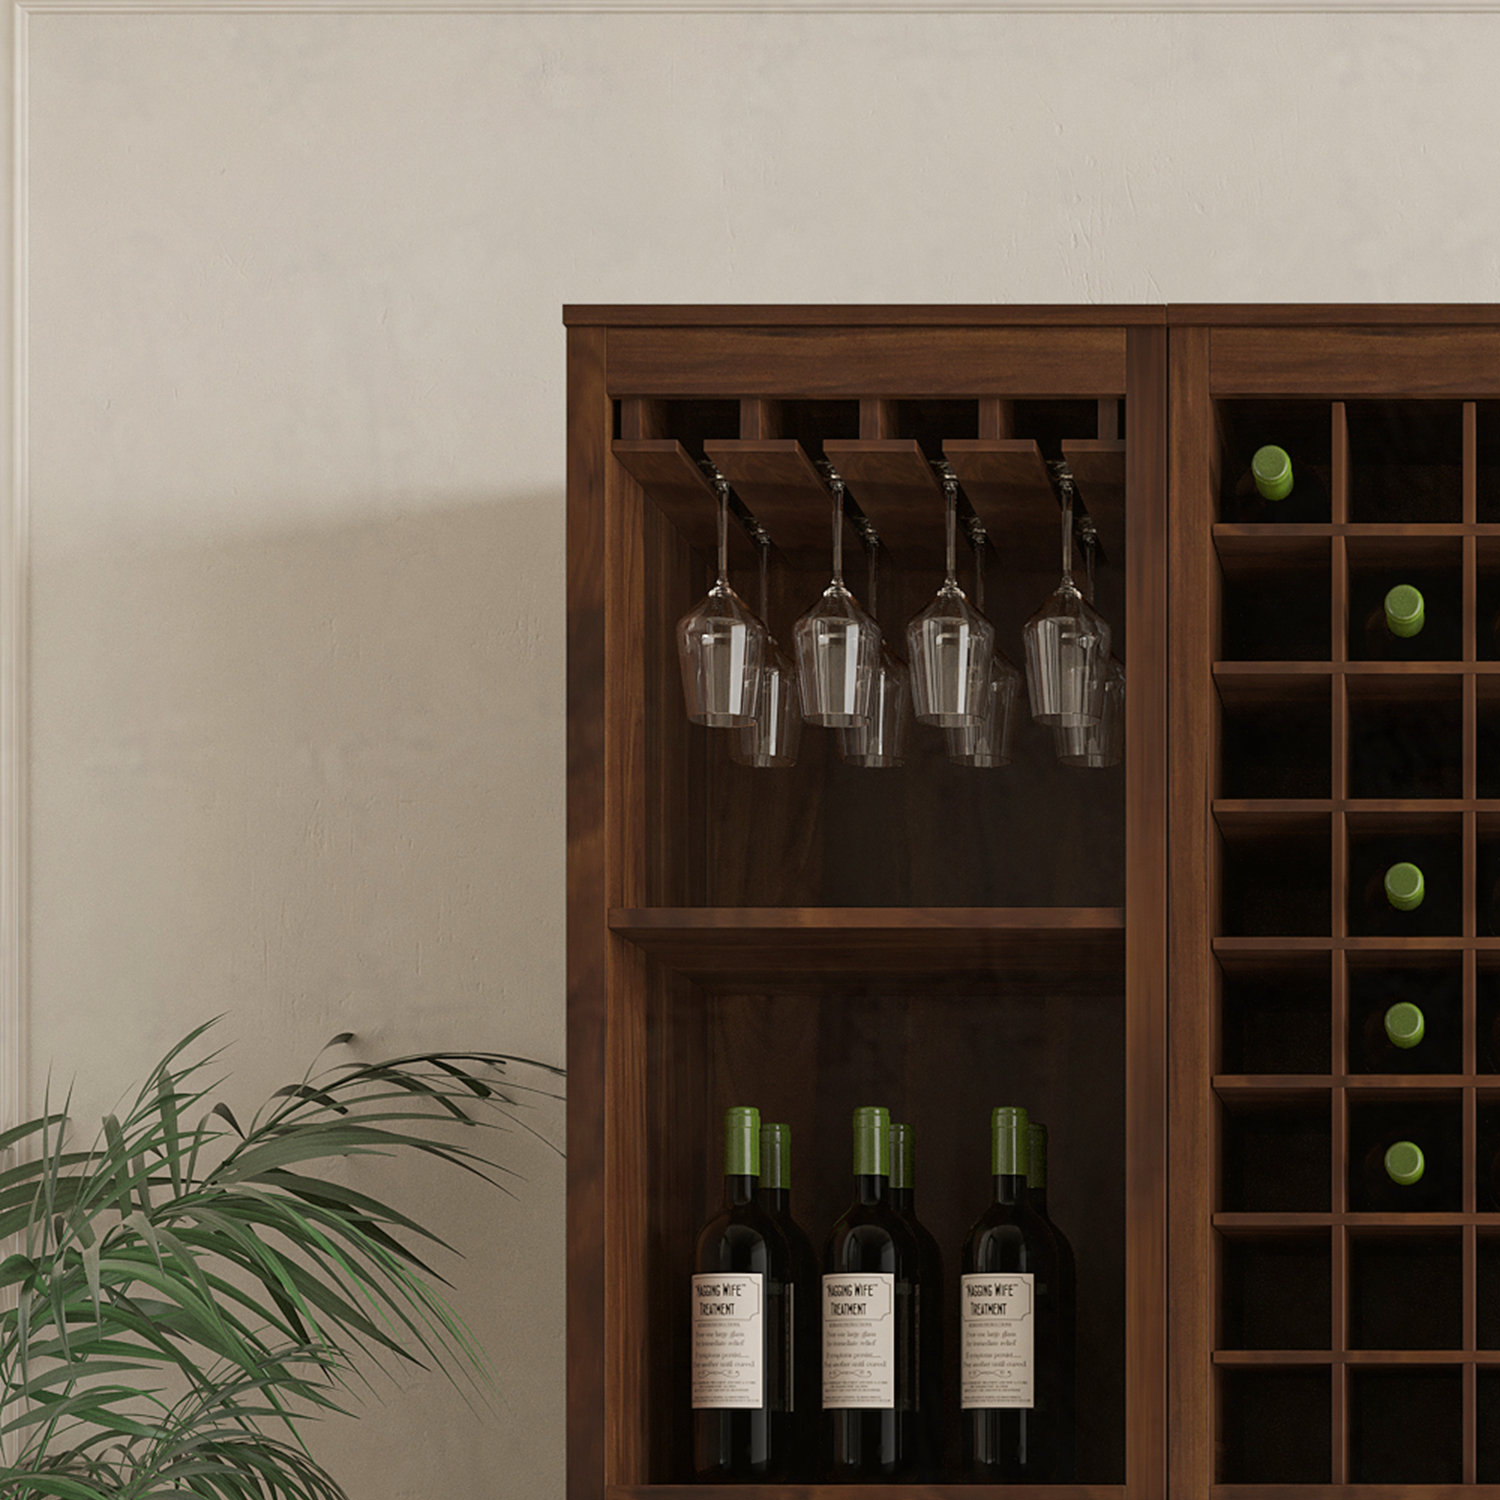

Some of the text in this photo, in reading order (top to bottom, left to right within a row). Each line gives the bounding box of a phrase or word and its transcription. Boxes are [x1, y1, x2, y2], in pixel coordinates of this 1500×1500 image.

[700, 1302, 735, 1316] TREATMENT
[831, 1302, 866, 1316] TREATMENT
[970, 1302, 1007, 1316] TREATMENT
